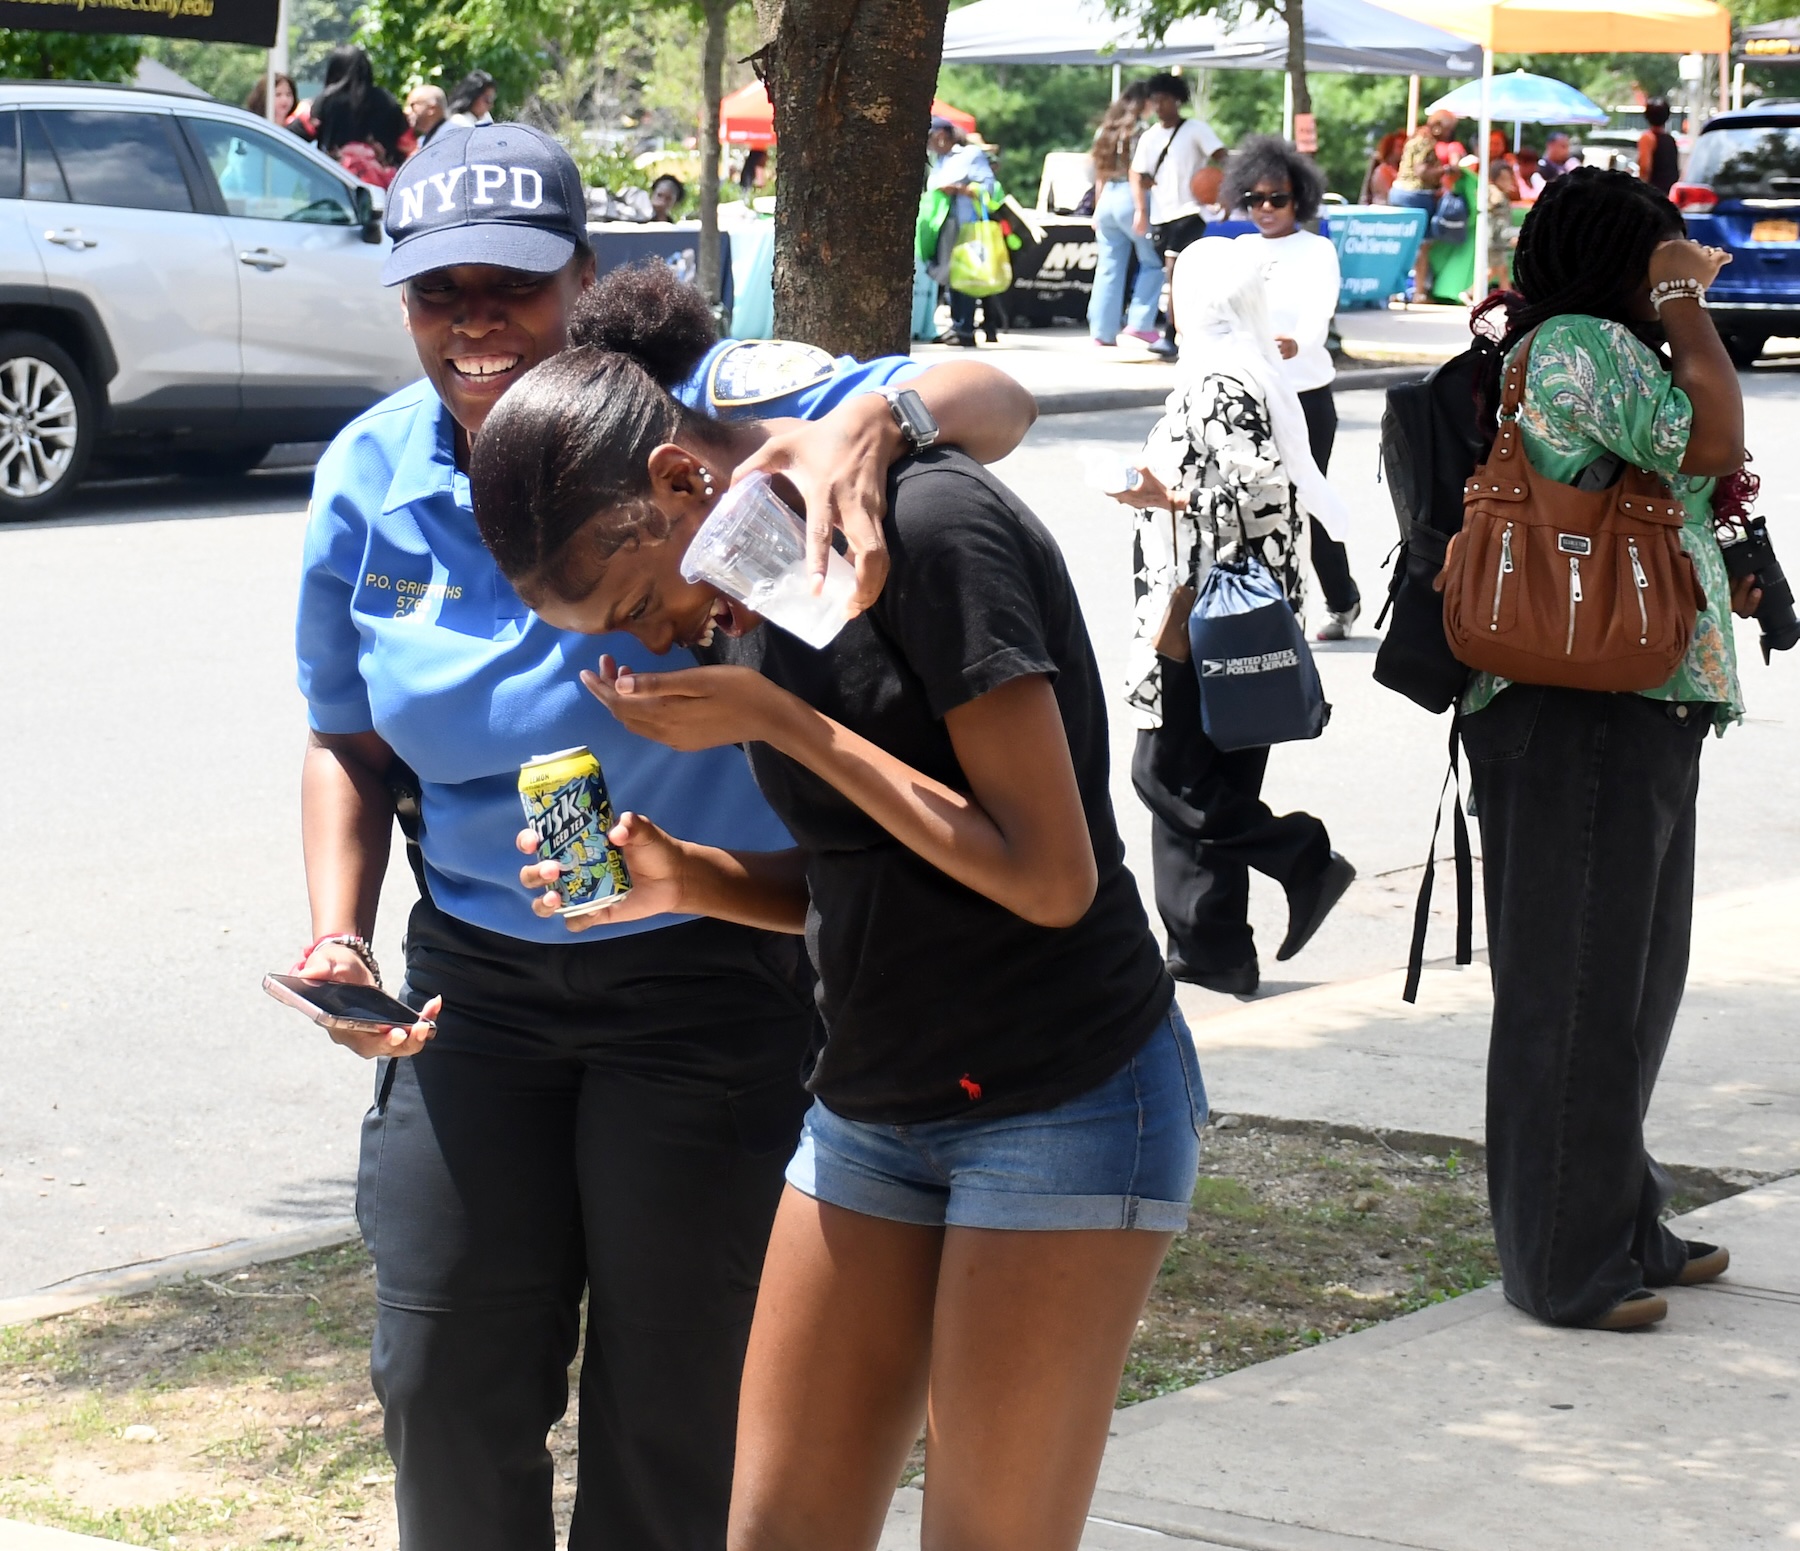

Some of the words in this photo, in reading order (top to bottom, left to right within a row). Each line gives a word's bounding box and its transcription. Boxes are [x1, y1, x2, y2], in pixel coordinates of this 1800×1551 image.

[399, 164, 543, 228] NYPD
[365, 573, 391, 590] P.O.
[396, 595, 431, 611] 576
[1226, 655, 1260, 667] UNITED
[1262, 649, 1294, 661] STATES
[1226, 663, 1260, 675] POSTAL
[1262, 656, 1298, 671] SERVICE
[530, 774, 549, 784] LEMON
[553, 829, 569, 849] ICED
[570, 816, 585, 834] TEA
